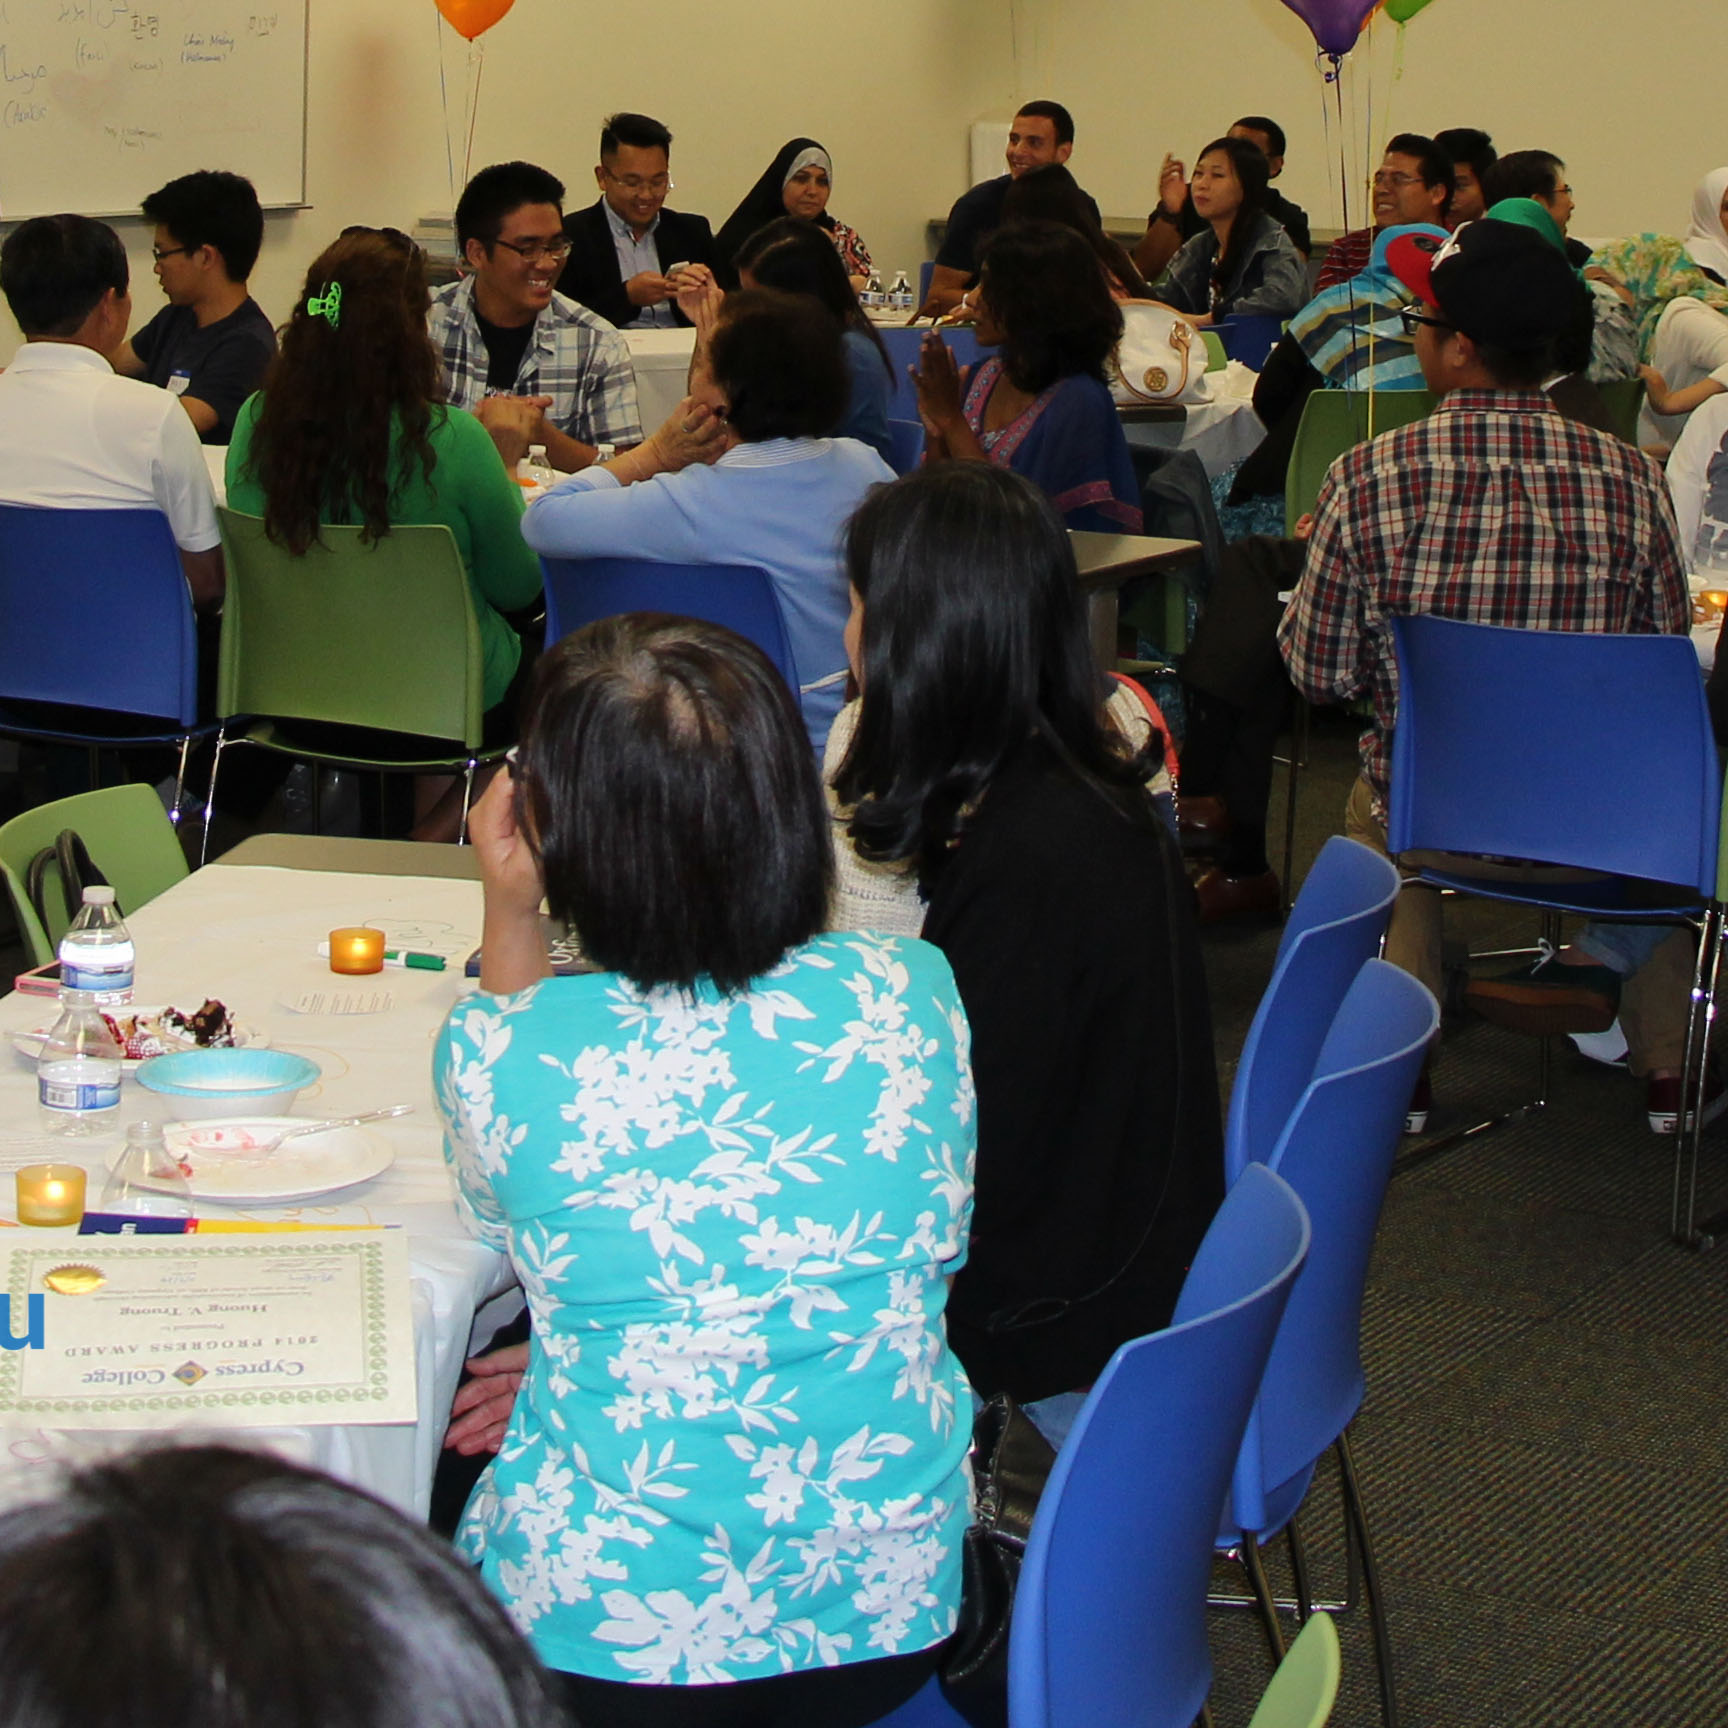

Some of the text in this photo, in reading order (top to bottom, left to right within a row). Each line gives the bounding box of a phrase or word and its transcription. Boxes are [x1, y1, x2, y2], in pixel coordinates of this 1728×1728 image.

[64, 1343, 138, 1358] AWARD
[149, 1337, 264, 1353] PROGRESS
[80, 1358, 306, 1387] Cypress College
